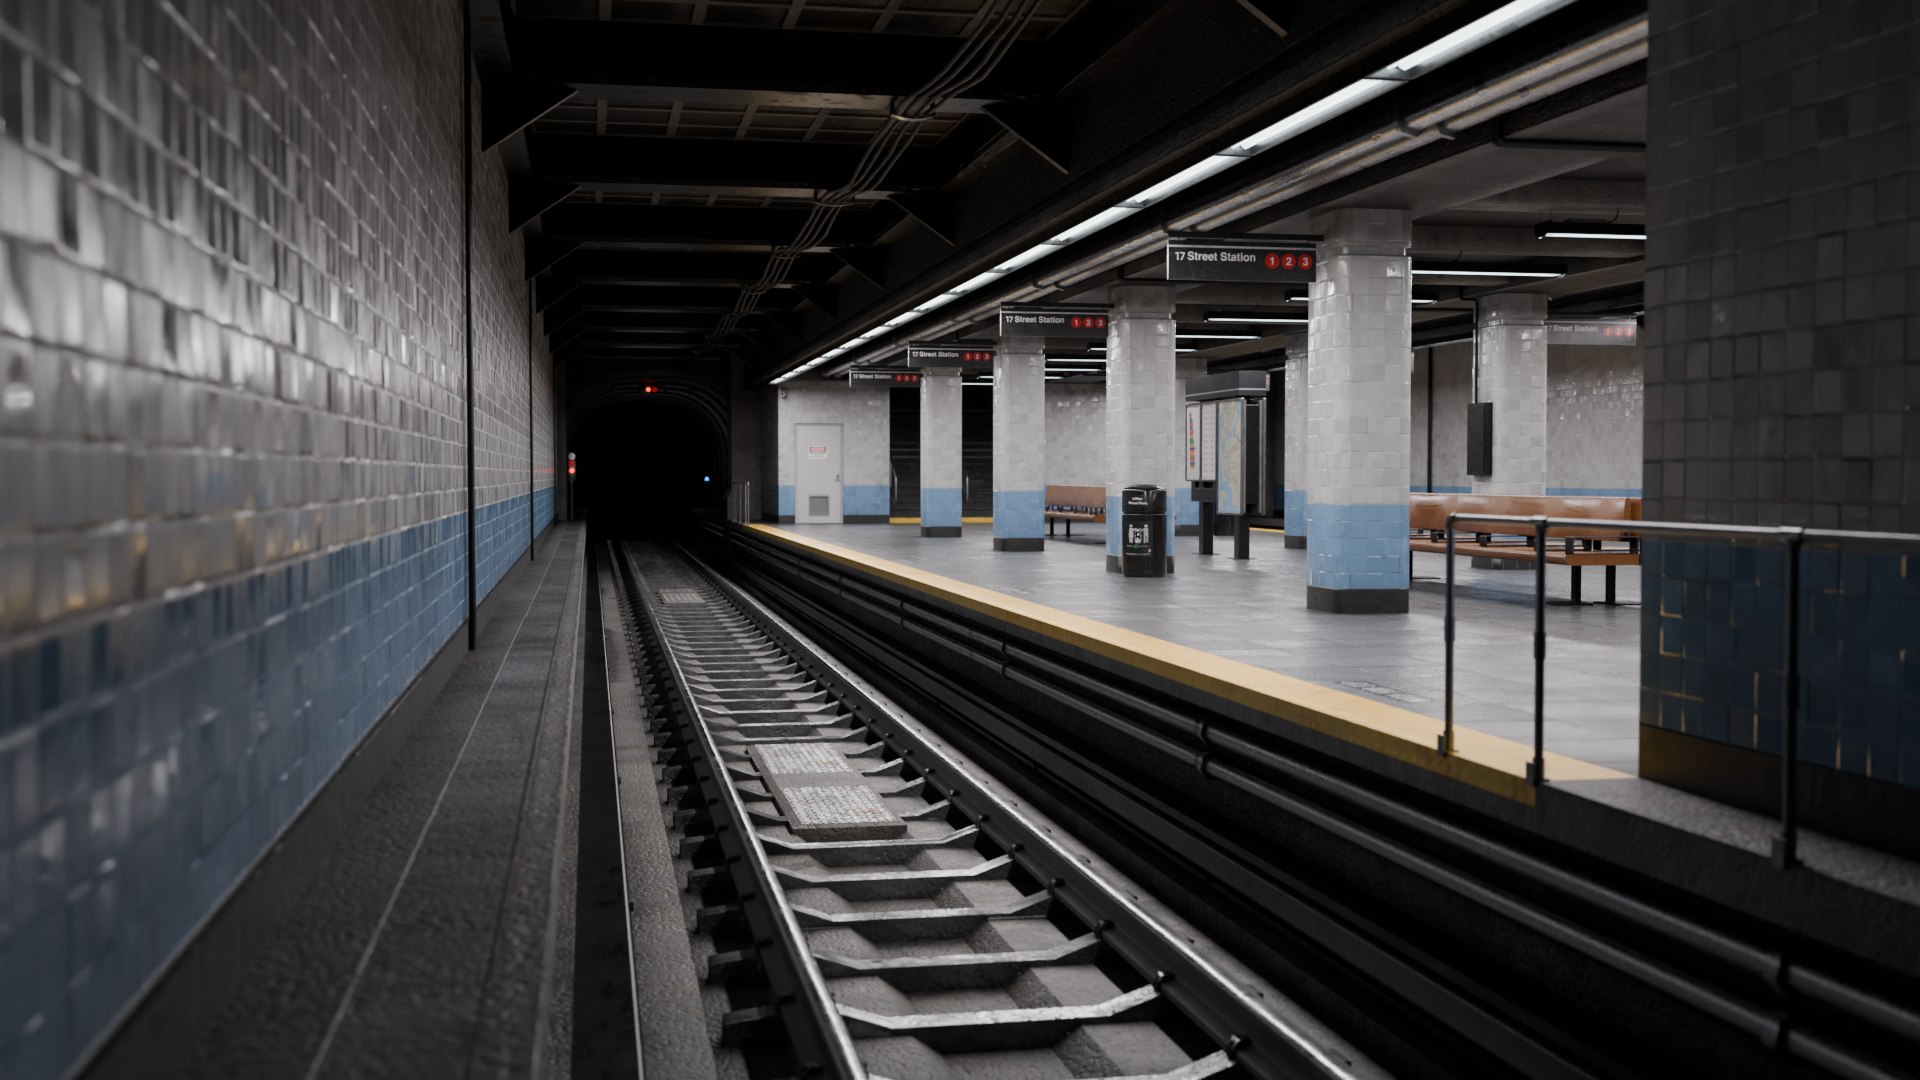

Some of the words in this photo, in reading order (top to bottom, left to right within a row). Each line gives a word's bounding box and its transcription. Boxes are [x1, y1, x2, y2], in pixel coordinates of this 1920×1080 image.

[1175, 251, 1186, 261] 17
[1187, 250, 1218, 262] Street
[1220, 251, 1257, 262] Station
[1005, 315, 1013, 323] 17
[1014, 315, 1037, 324] Street
[1038, 316, 1065, 324] Station
